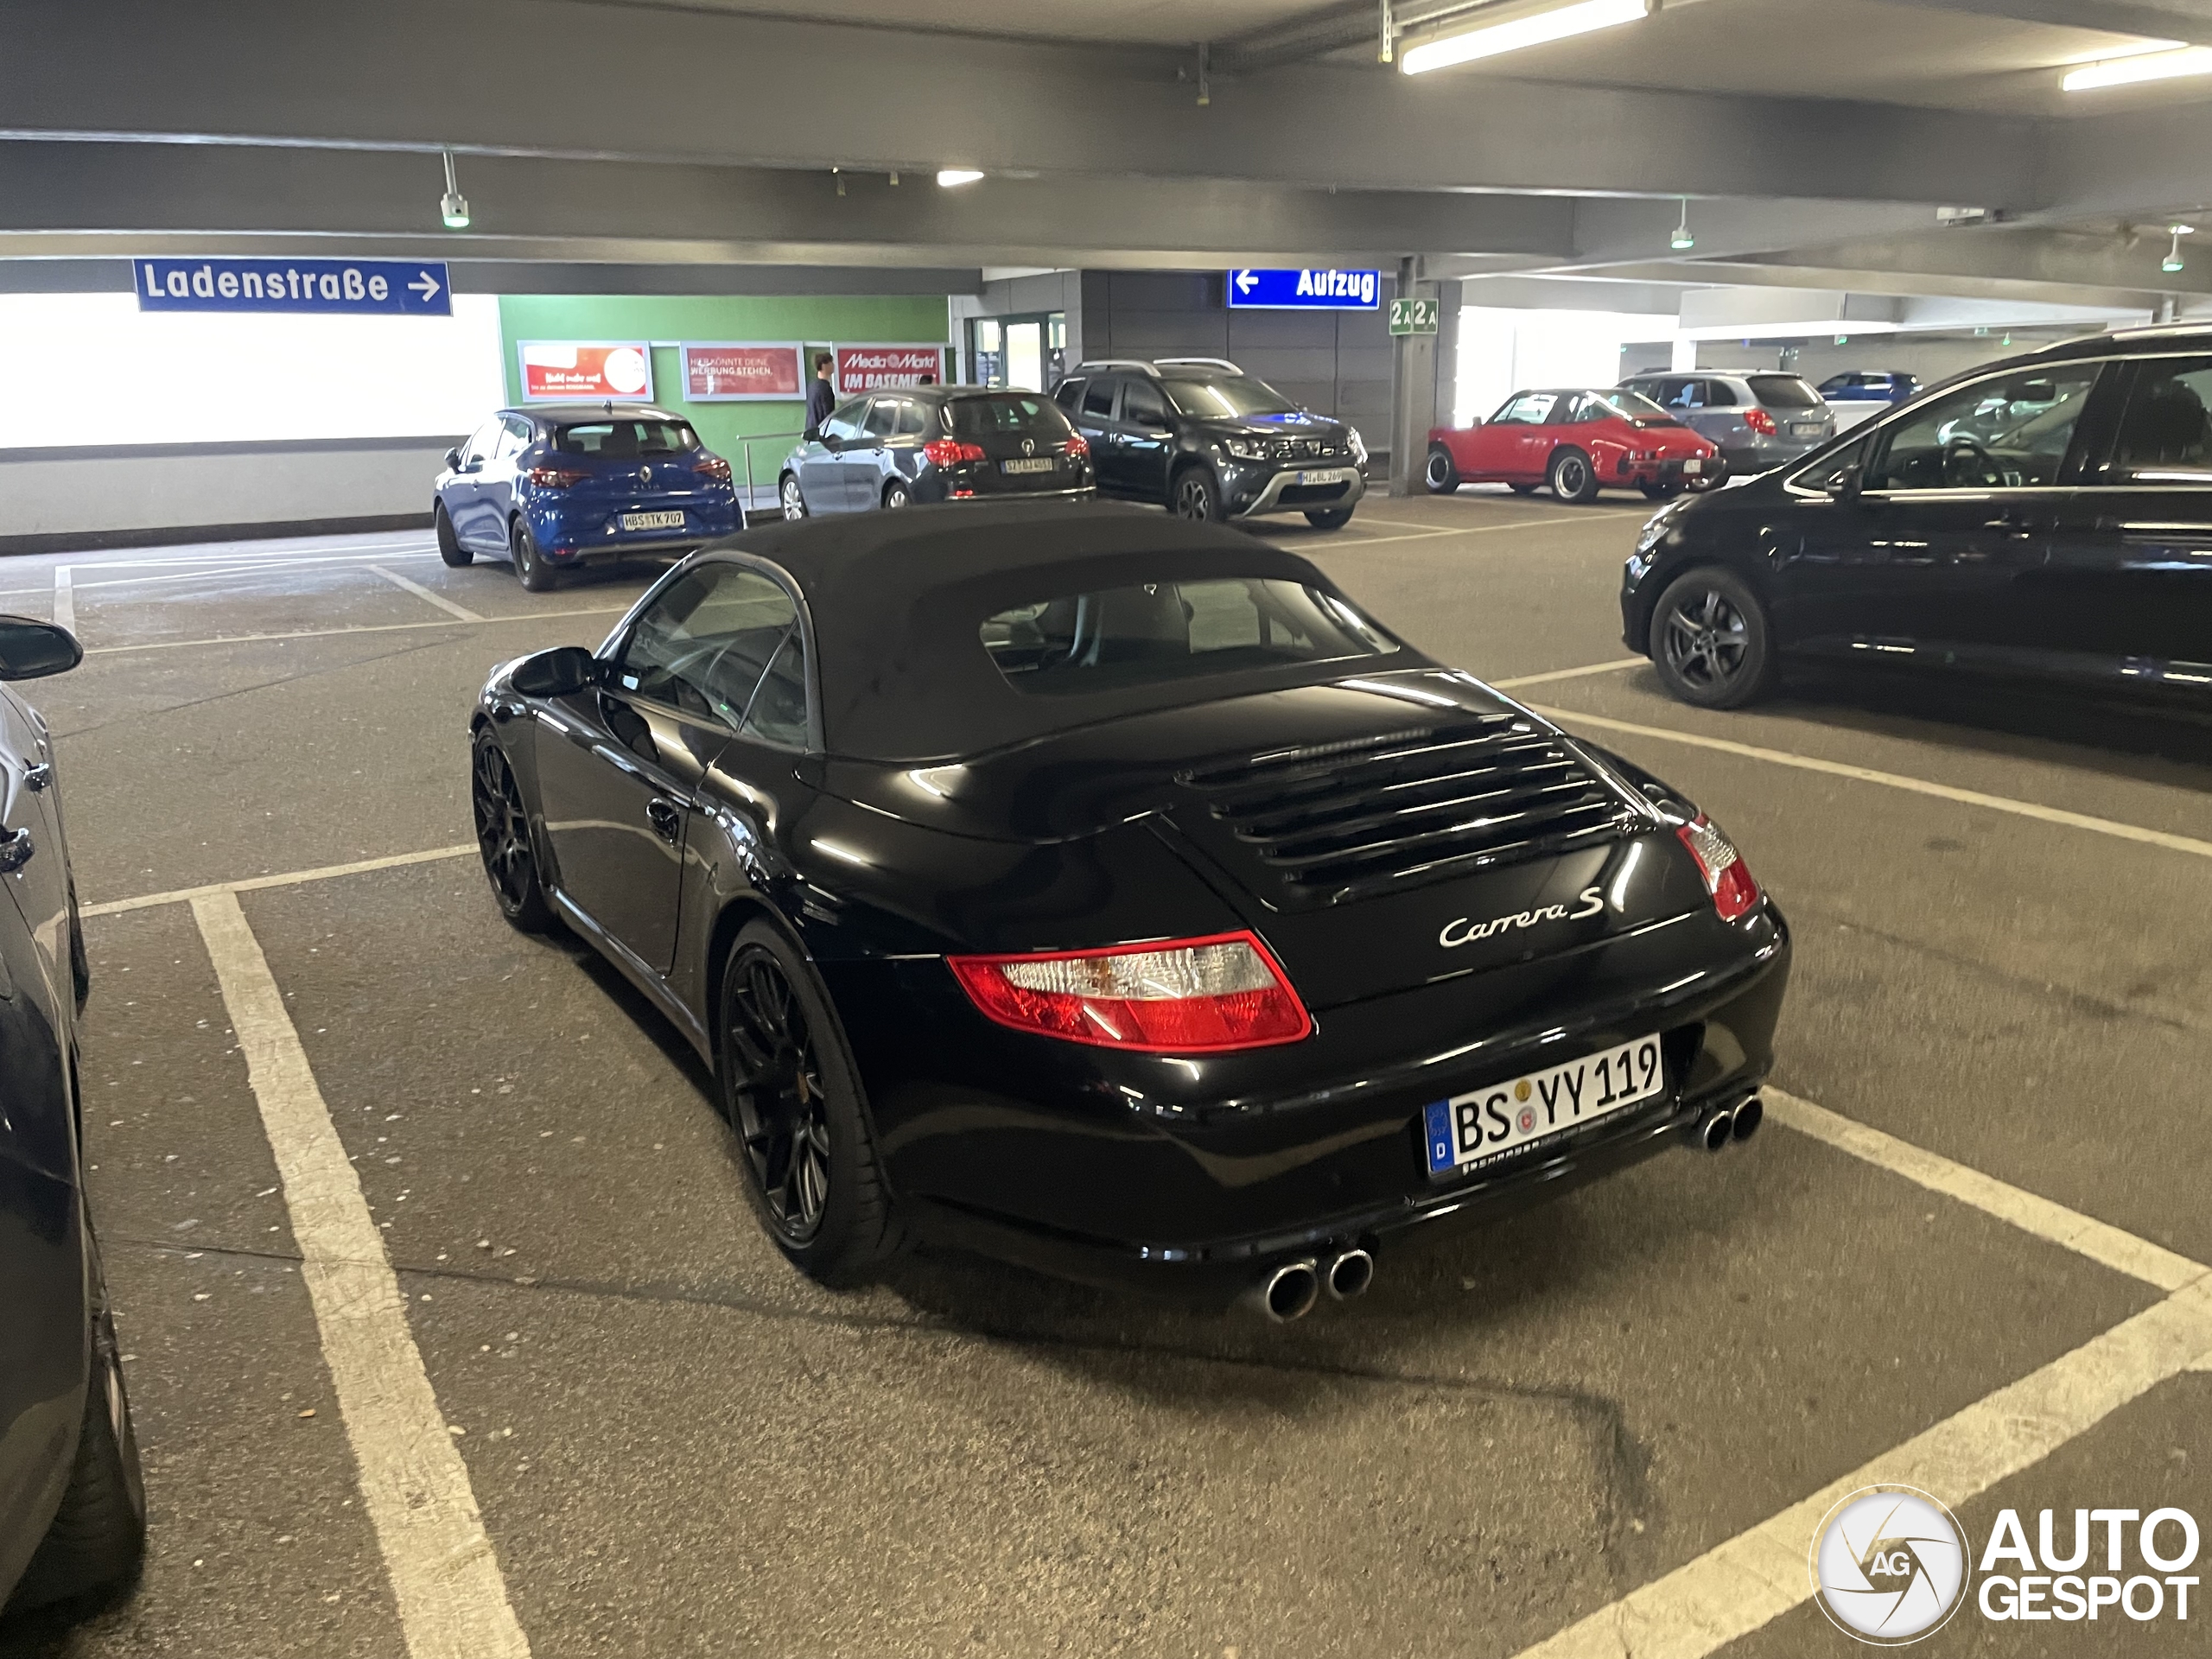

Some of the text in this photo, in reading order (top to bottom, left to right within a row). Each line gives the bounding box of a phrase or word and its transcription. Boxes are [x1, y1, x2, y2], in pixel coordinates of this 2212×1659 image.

[144, 264, 389, 301] Ladenstraße
[1296, 269, 1375, 303] Aufzug
[711, 356, 743, 366] KÖNNTE
[844, 353, 935, 369] Media Markt
[690, 367, 735, 376] WERBUNG
[844, 373, 936, 389] IM BASEME
[625, 512, 682, 527] HBS TK 707
[1440, 887, 1604, 949] Carrera S
[1455, 1092, 1511, 1154] BS
[1538, 1065, 1586, 1124] YY
[1594, 1042, 1657, 1108] 119
[1436, 1142, 1446, 1160] D
